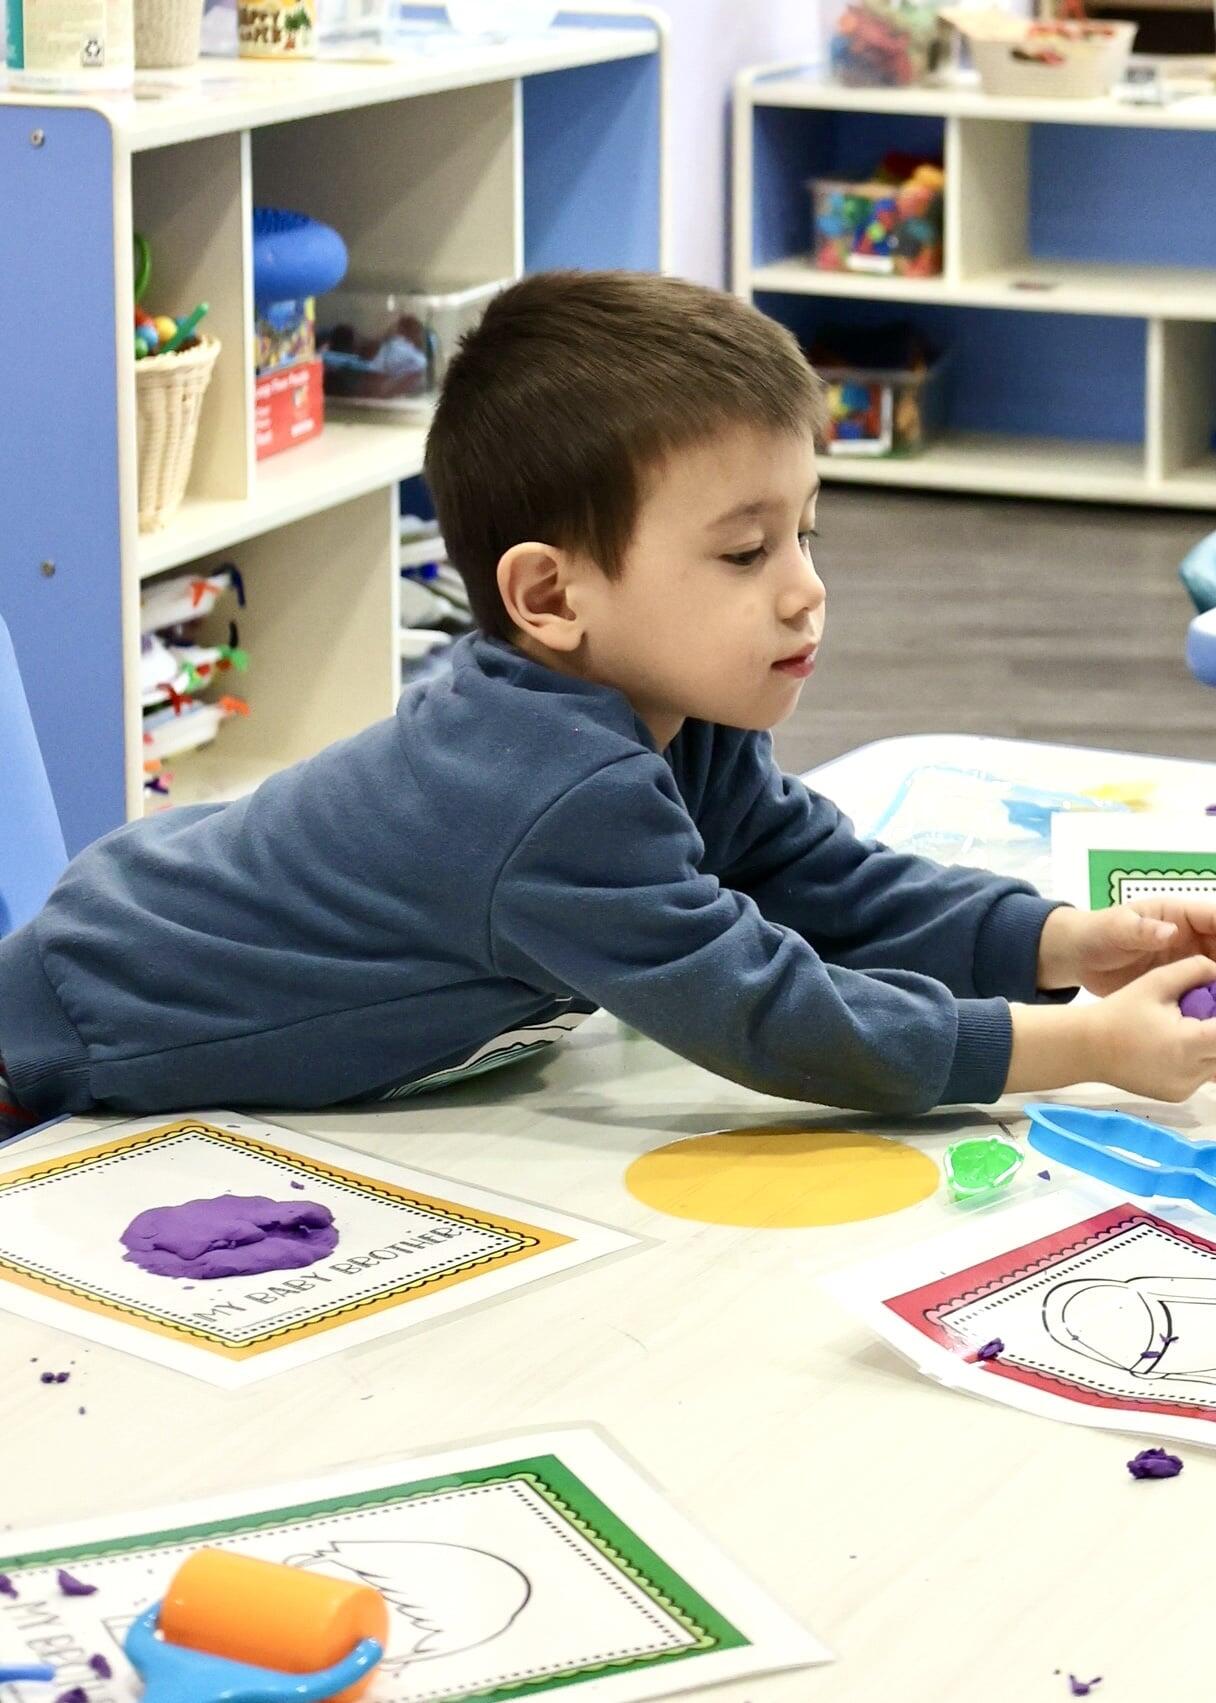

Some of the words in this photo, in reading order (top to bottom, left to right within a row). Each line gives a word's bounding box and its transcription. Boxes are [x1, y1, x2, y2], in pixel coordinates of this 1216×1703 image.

[192, 1300, 247, 1323] MY
[245, 1271, 333, 1304] BABY
[329, 1227, 462, 1275] BROTHER
[2, 1600, 64, 1631] MY
